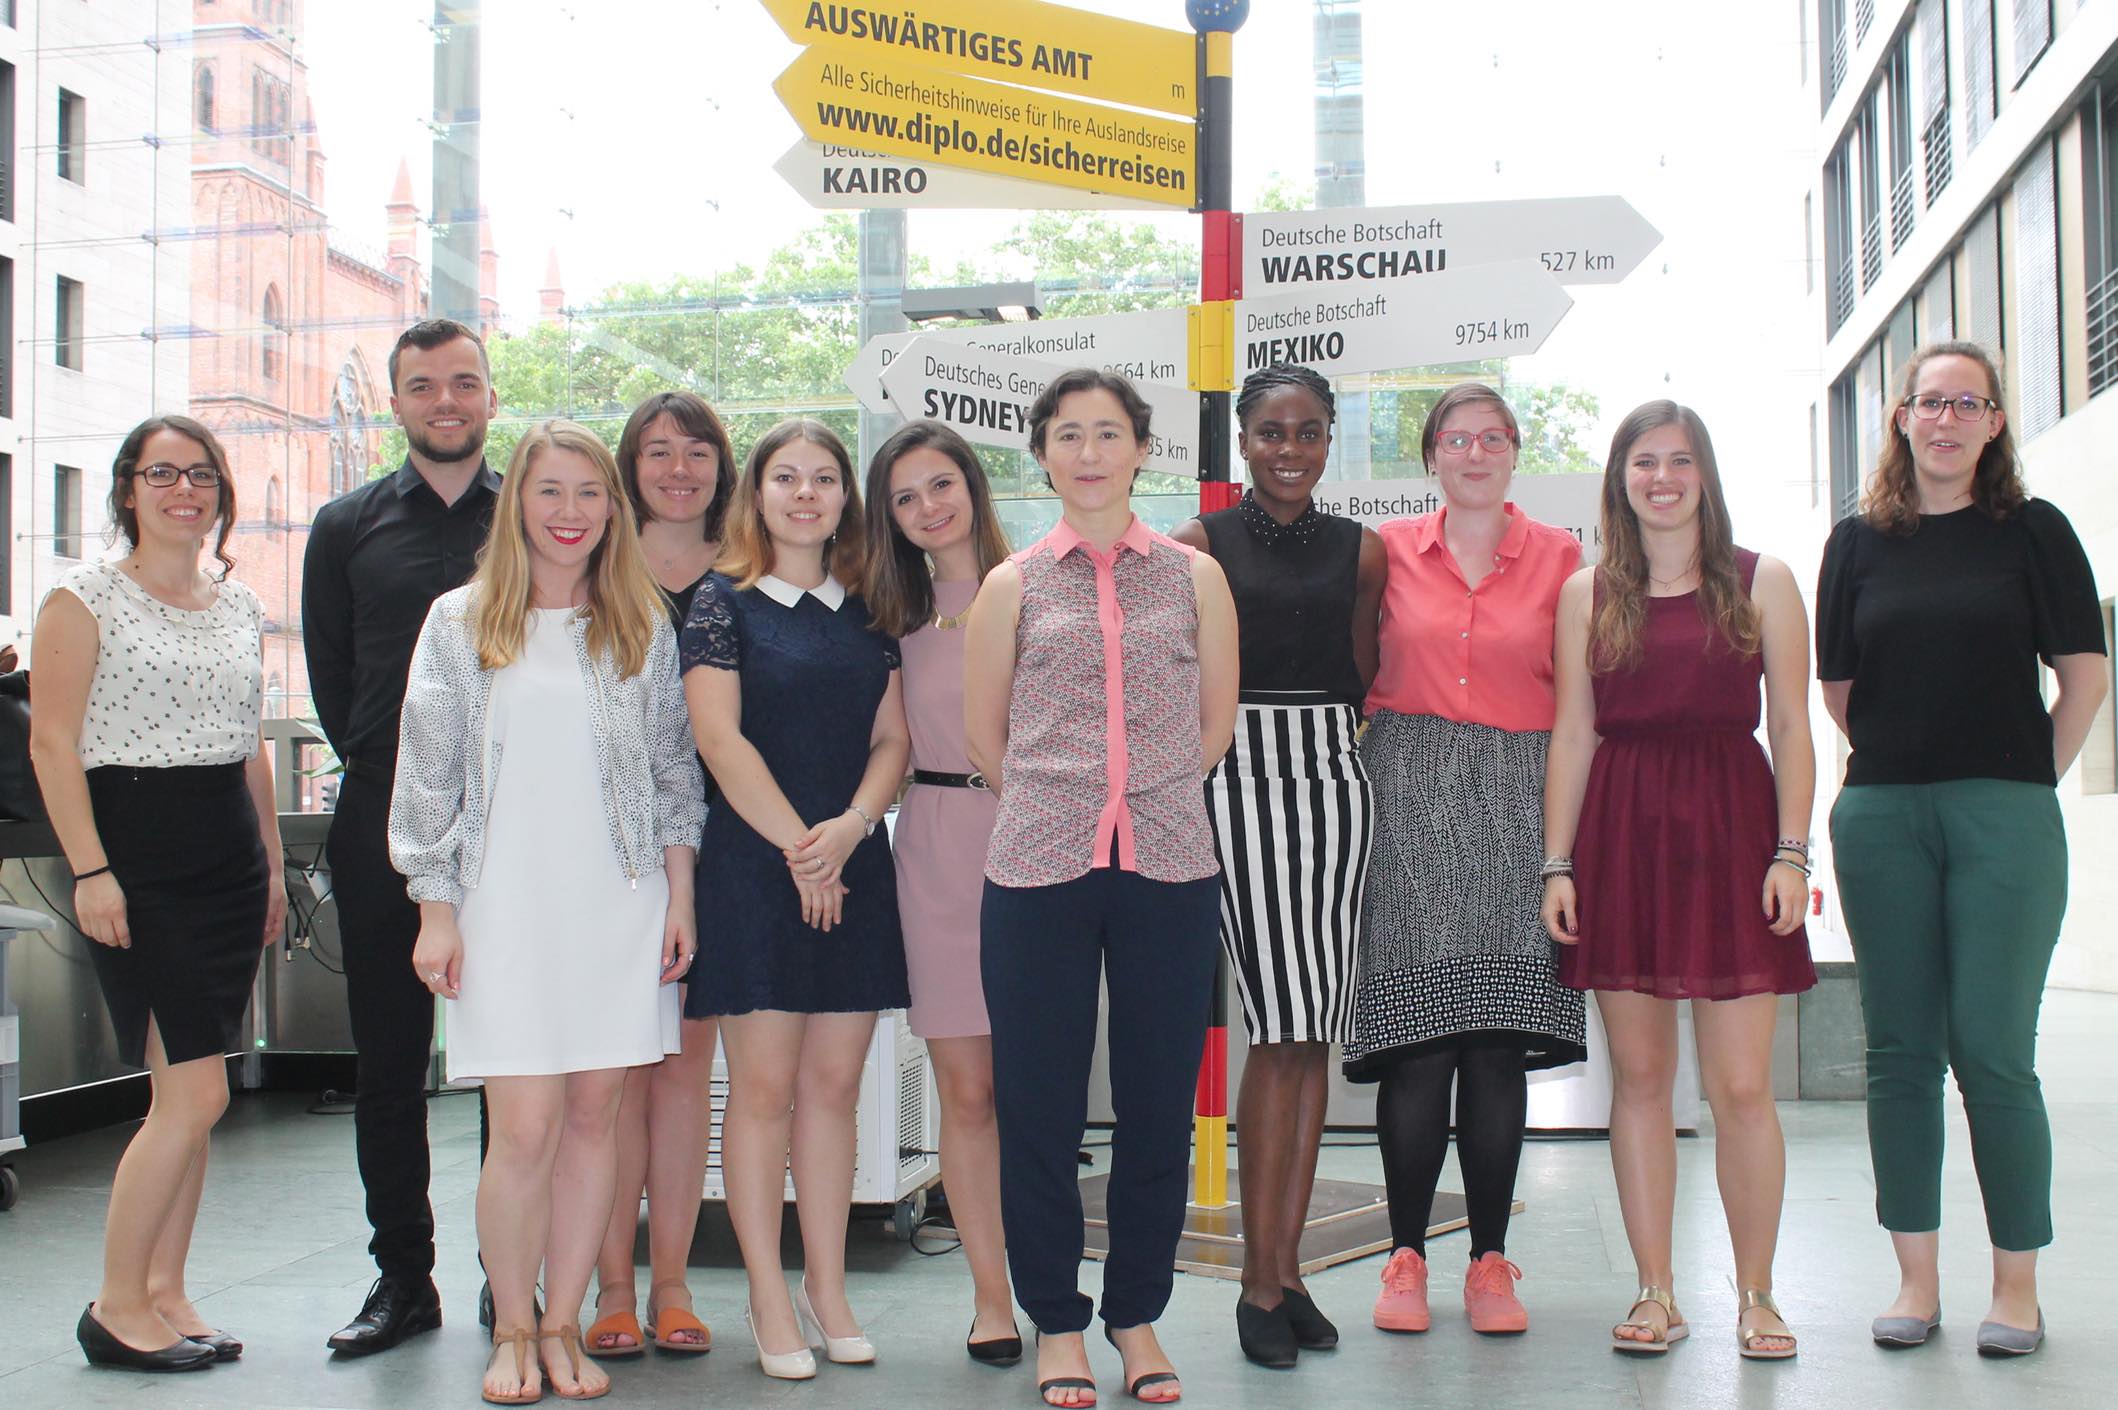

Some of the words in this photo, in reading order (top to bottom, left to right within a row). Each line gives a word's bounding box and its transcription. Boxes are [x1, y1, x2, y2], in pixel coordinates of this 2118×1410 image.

[805, 1, 1023, 67] AUSWÄRTIGES
[1032, 46, 1093, 80] AMT
[820, 65, 854, 90] Alle
[860, 72, 1021, 123] Sicherheitshinweise
[1026, 104, 1048, 127] für
[1053, 110, 1081, 136] Ihre
[1086, 119, 1186, 154] Auslandsreise
[818, 102, 1186, 190] www.diplo.de/sicherreisen
[824, 168, 927, 194] KAIRO
[1262, 227, 1346, 247] Deutsche
[1354, 219, 1443, 242] Botschaft
[1262, 249, 1446, 284] WARSCHAU
[1541, 252, 1577, 271] 527
[1585, 250, 1615, 271] km
[1247, 309, 1311, 333] Deutsche
[1316, 295, 1387, 324] Botschaft
[1455, 322, 1498, 345] 9754
[1503, 318, 1529, 340] km
[1247, 331, 1344, 369] MEXIKO
[925, 355, 1002, 390] Deutsches
[1150, 360, 1175, 379] km
[1168, 438, 1188, 460] km
[1349, 493, 1438, 515] Botschaft
